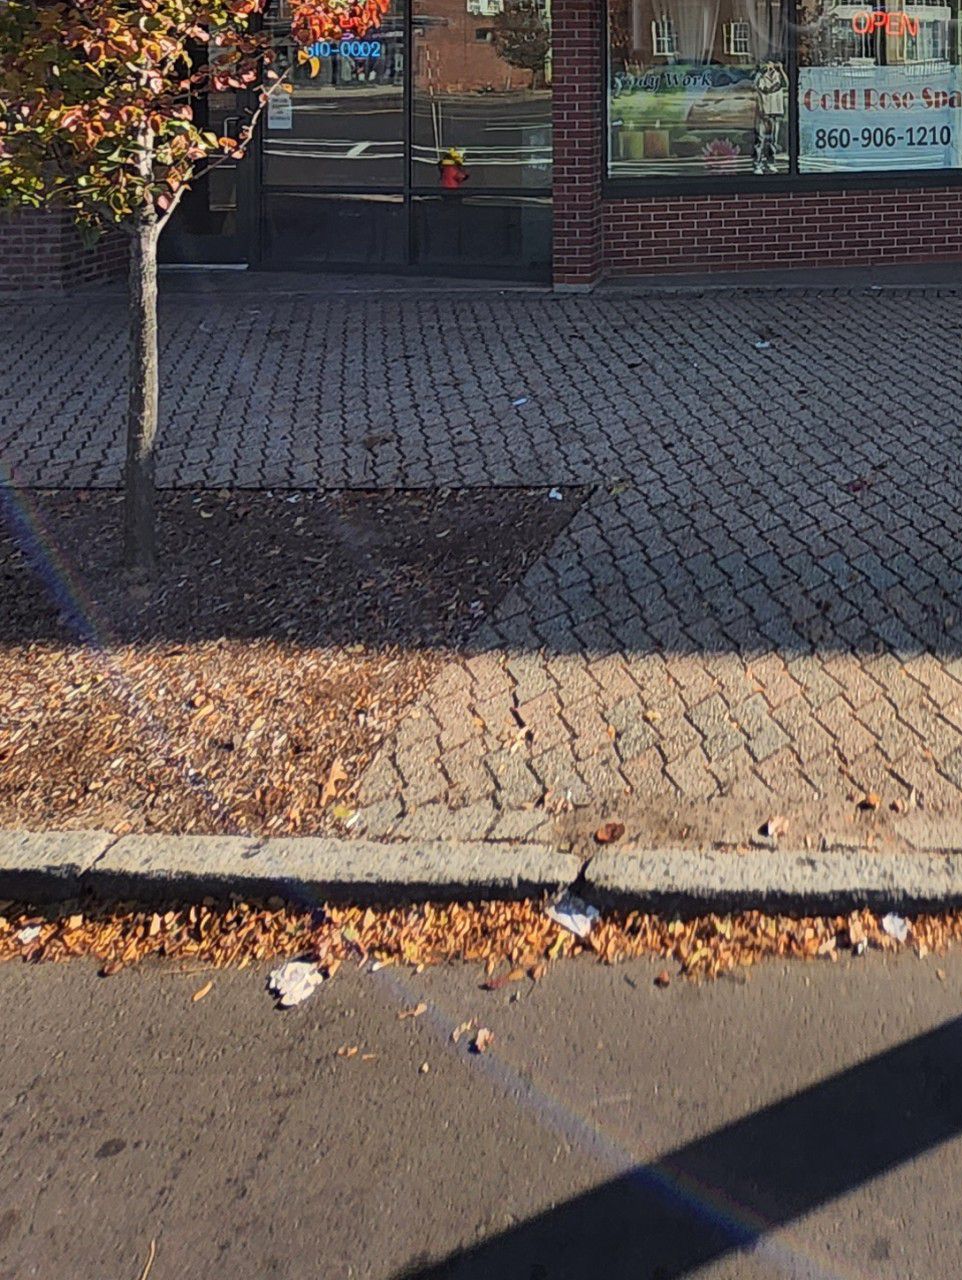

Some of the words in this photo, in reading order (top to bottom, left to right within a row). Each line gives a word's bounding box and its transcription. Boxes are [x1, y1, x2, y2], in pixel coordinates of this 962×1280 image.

[851, 10, 921, 38] OPEN
[664, 70, 713, 89] Work
[803, 87, 856, 112] Gold
[864, 87, 914, 112] Rose
[921, 86, 962, 110] Spa
[815, 125, 951, 149] 860-906-1210
